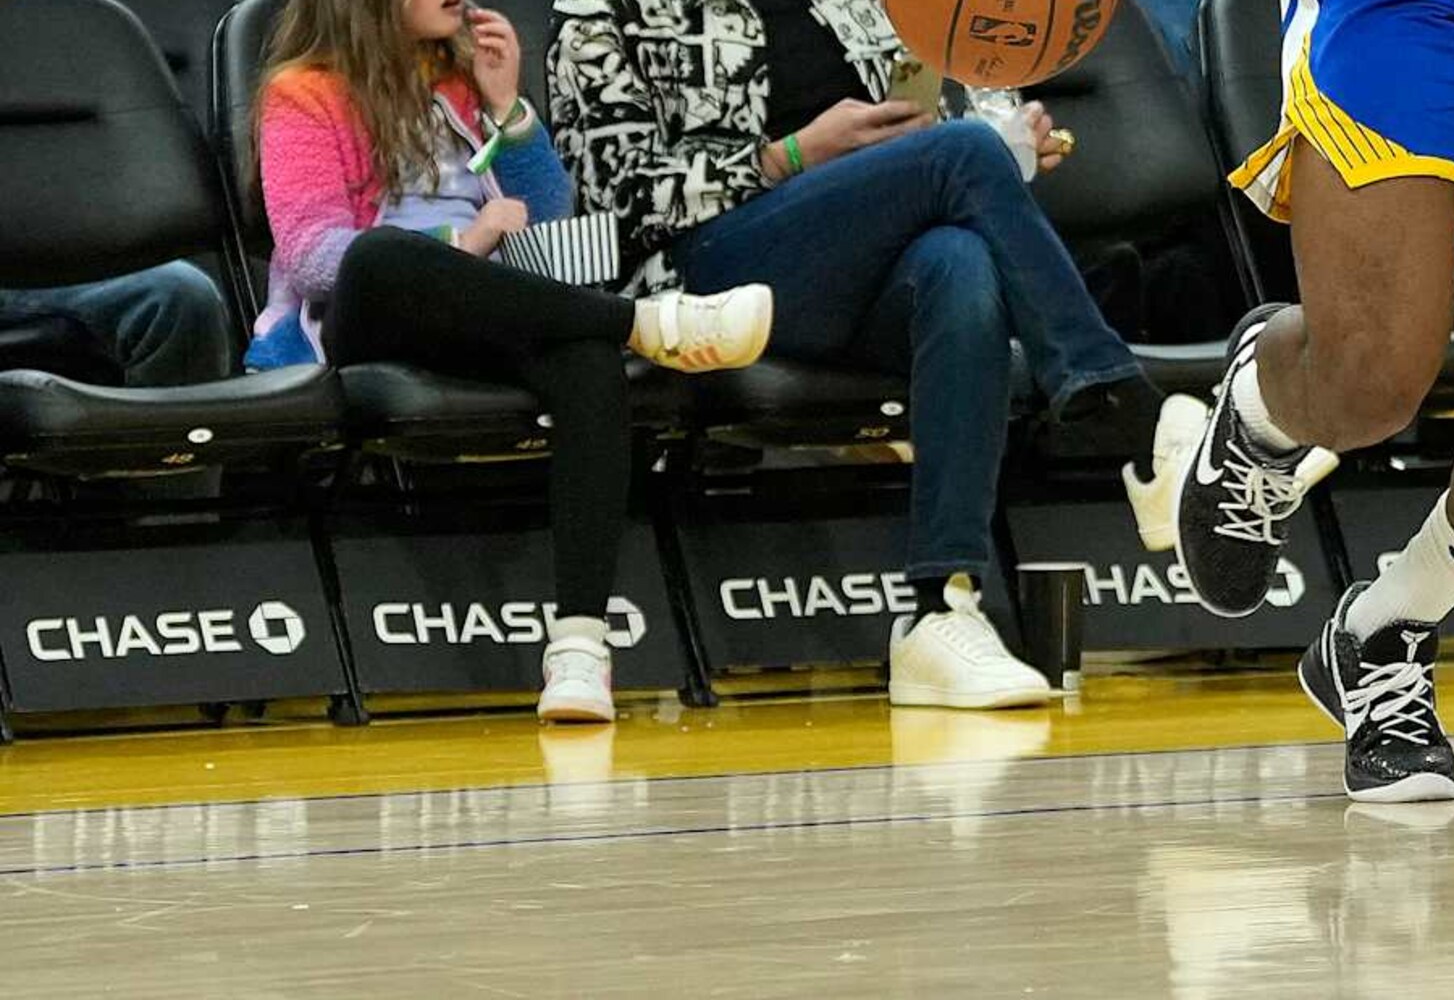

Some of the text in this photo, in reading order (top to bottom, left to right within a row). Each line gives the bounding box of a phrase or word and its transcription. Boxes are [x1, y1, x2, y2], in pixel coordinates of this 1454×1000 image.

[719, 571, 919, 620] CHASE
[1082, 563, 1202, 606] HAS
[26, 609, 243, 662] CHASE
